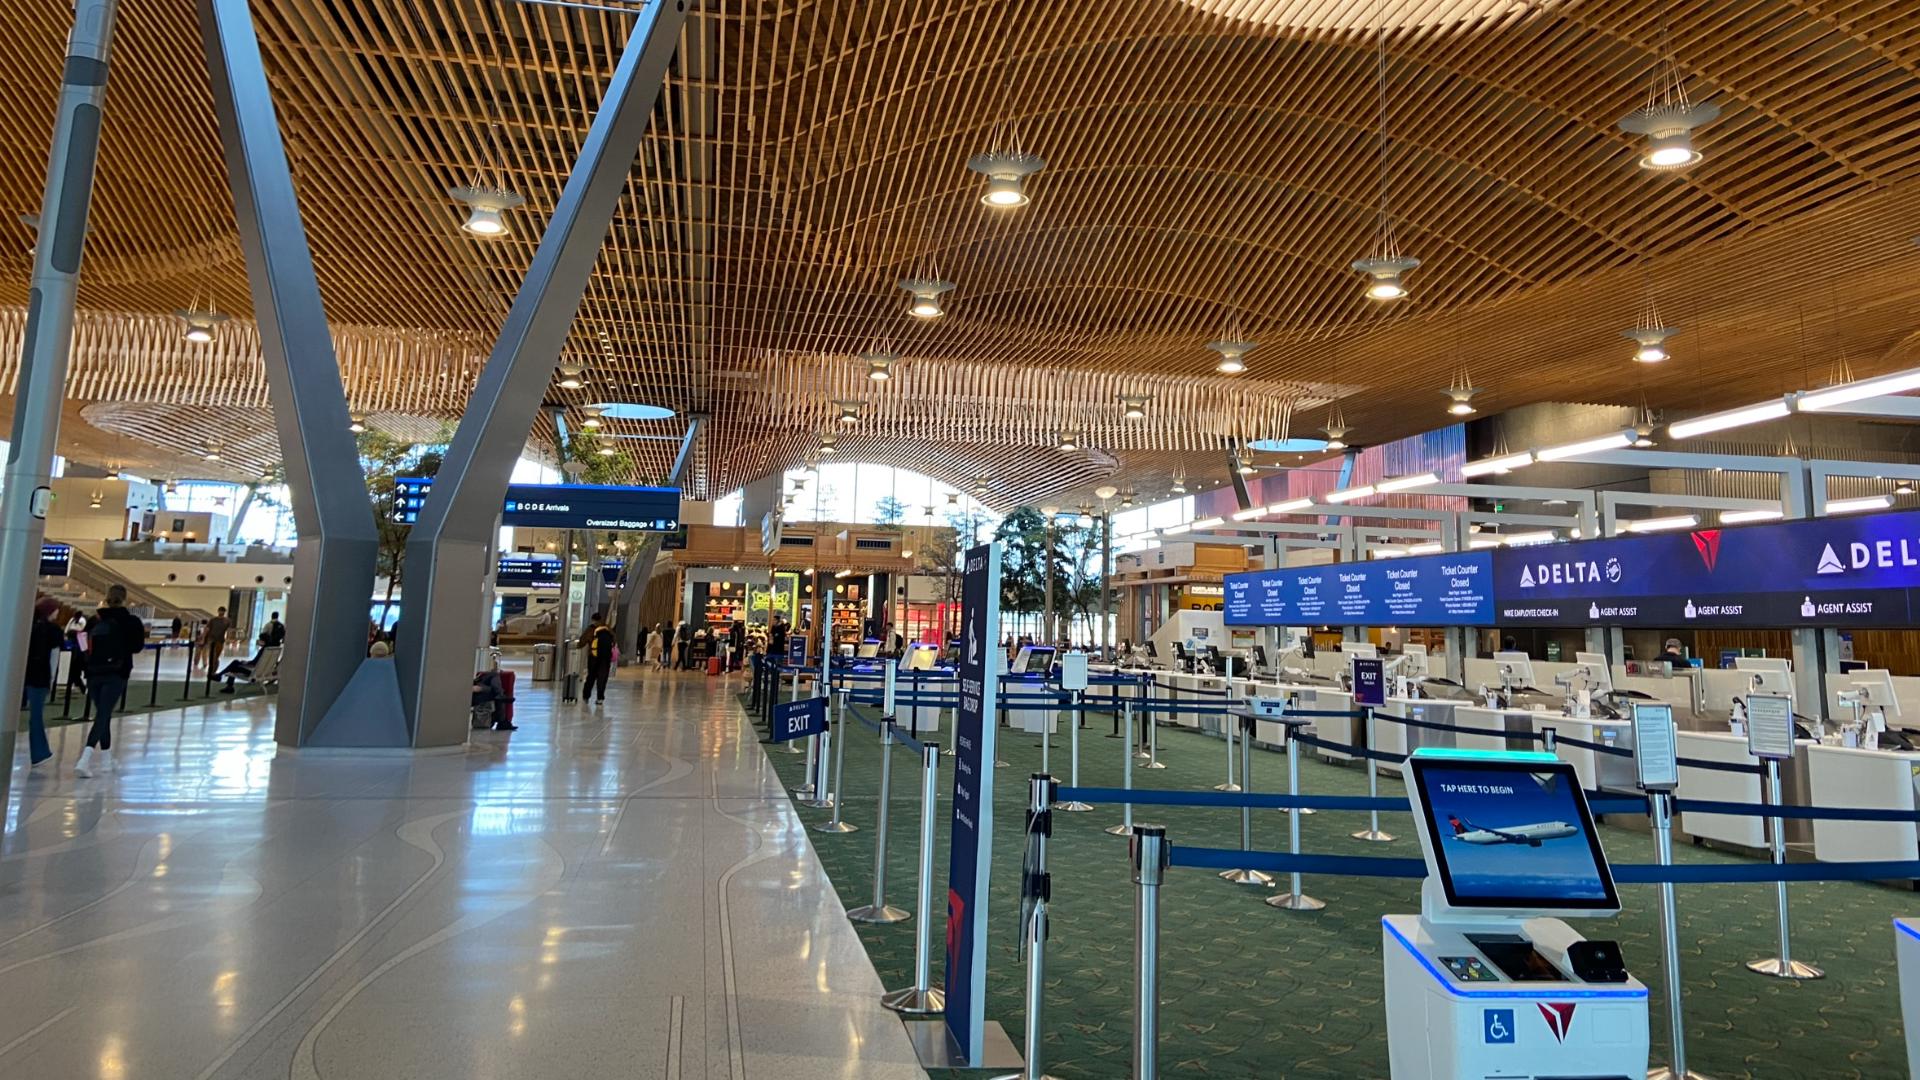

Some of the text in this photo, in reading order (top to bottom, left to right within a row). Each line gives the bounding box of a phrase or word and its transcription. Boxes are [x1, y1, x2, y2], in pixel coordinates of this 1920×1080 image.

[532, 503, 538, 511] D
[545, 504, 570, 512] Arrivals
[586, 519, 618, 527] Oversized
[619, 520, 647, 529] Baggage
[1850, 538, 1920, 569] DEL
[1387, 569, 1418, 579] Ticket Counter
[1441, 564, 1479, 575] Ticket Counter
[1538, 561, 1601, 585] DELTA
[1394, 581, 1411, 591] Closed
[1451, 577, 1470, 588] Closed
[1514, 609, 1537, 617] EMPLOYEE
[1537, 608, 1559, 617] CHECK-IN
[1600, 607, 1637, 616] AGENT ASSIST
[1697, 605, 1743, 615] AGENT ASSIST
[1817, 602, 1873, 614] AGENT ASSIST
[1361, 672, 1377, 680] EXIT
[788, 714, 811, 733] EXIT
[1440, 784, 1514, 794] TAP HERE TO BEGIN
